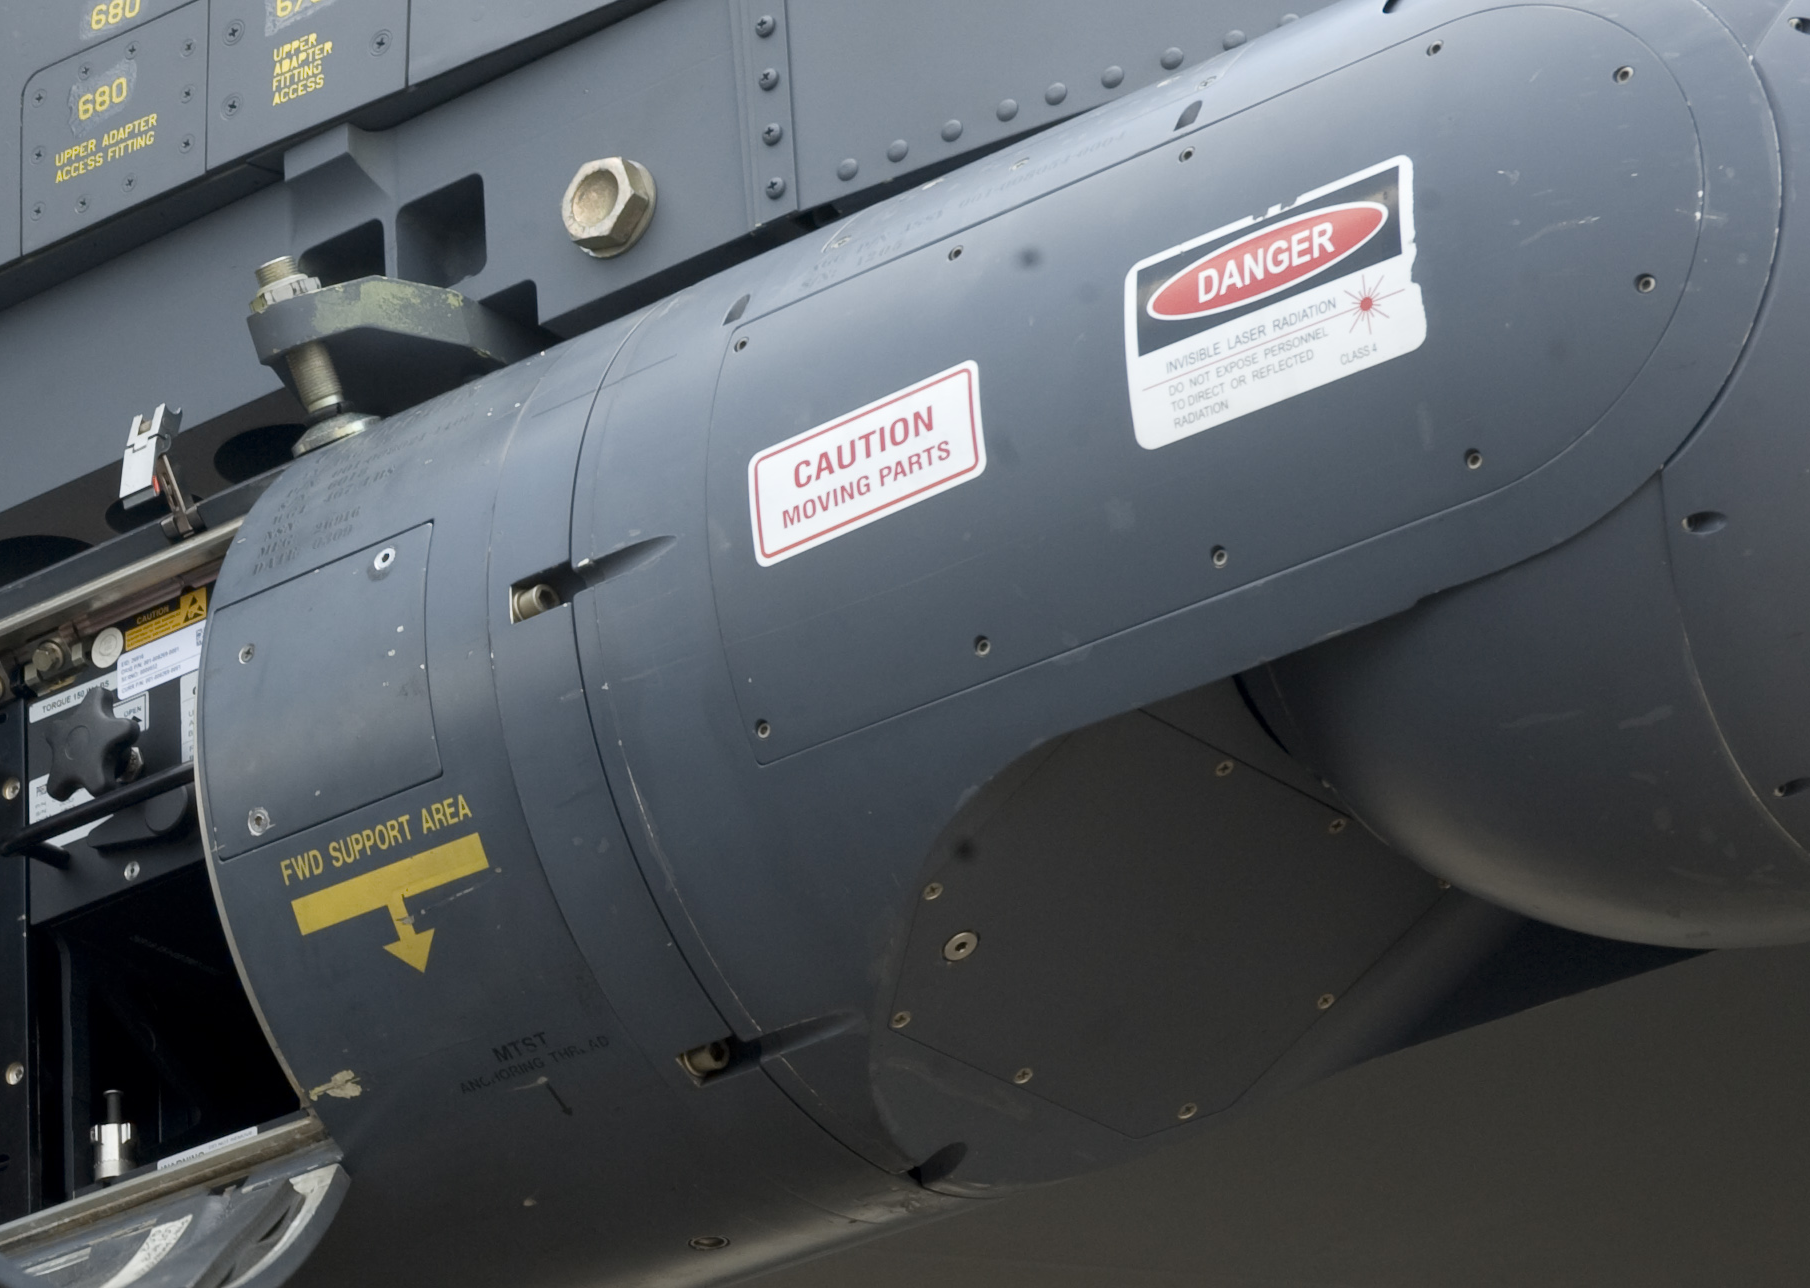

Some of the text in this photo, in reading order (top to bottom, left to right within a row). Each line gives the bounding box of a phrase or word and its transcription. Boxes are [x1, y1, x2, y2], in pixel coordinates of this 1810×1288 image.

[273, 32, 318, 62] UPPER
[273, 40, 333, 77] ADAPTER
[272, 74, 325, 107] ACCESS
[273, 60, 322, 92] FITTING
[78, 77, 127, 121] 680
[55, 113, 158, 167] UPPER ADAPTER
[55, 131, 155, 184] ACCESS FITTING
[1198, 221, 1335, 304] DANGER
[1166, 297, 1337, 374] INVISIBLE LASER RADIATION
[1168, 327, 1329, 396] DO NOT EXPOSE PERSONNEL
[1340, 343, 1378, 366] CLASS 4
[1171, 349, 1314, 412] TO DIRECT OR REFLECTED
[1173, 399, 1229, 429] RADIATION
[794, 405, 934, 489] CAUTION
[782, 440, 951, 529] MOVING PARTS
[136, 605, 170, 625] CAUTION
[42, 692, 72, 714] TORQUE
[73, 688, 86, 703] 150
[123, 704, 141, 719] OPEN
[280, 794, 473, 886] FWD SUPPORT AREA
[493, 1031, 549, 1064] MTST
[549, 1035, 610, 1064] THRAD
